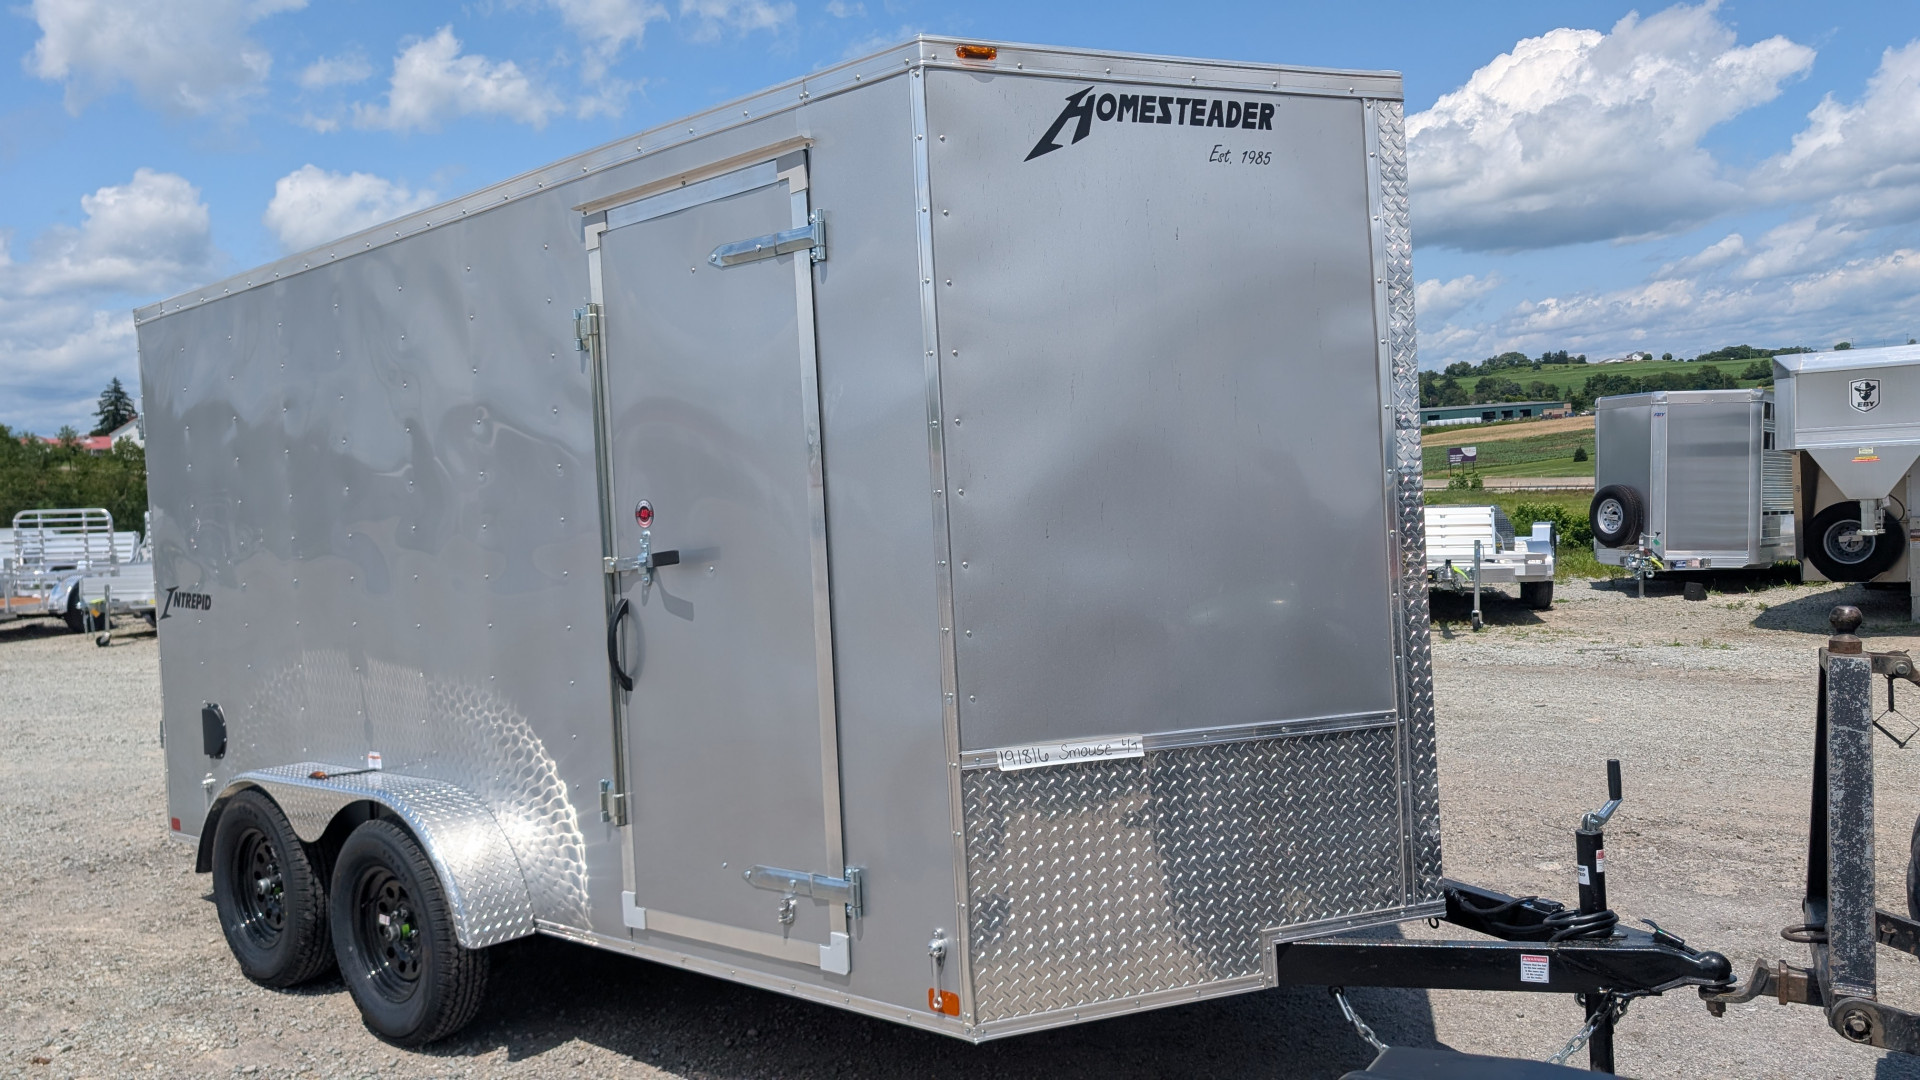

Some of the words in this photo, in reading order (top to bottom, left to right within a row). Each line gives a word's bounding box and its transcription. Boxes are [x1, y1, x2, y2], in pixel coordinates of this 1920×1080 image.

[1024, 86, 1275, 162] HOMESTEADER
[1209, 144, 1232, 165] Est.
[1241, 149, 1272, 165] 1985
[160, 586, 212, 620] INTREPID
[1059, 743, 1113, 760] Smouse
